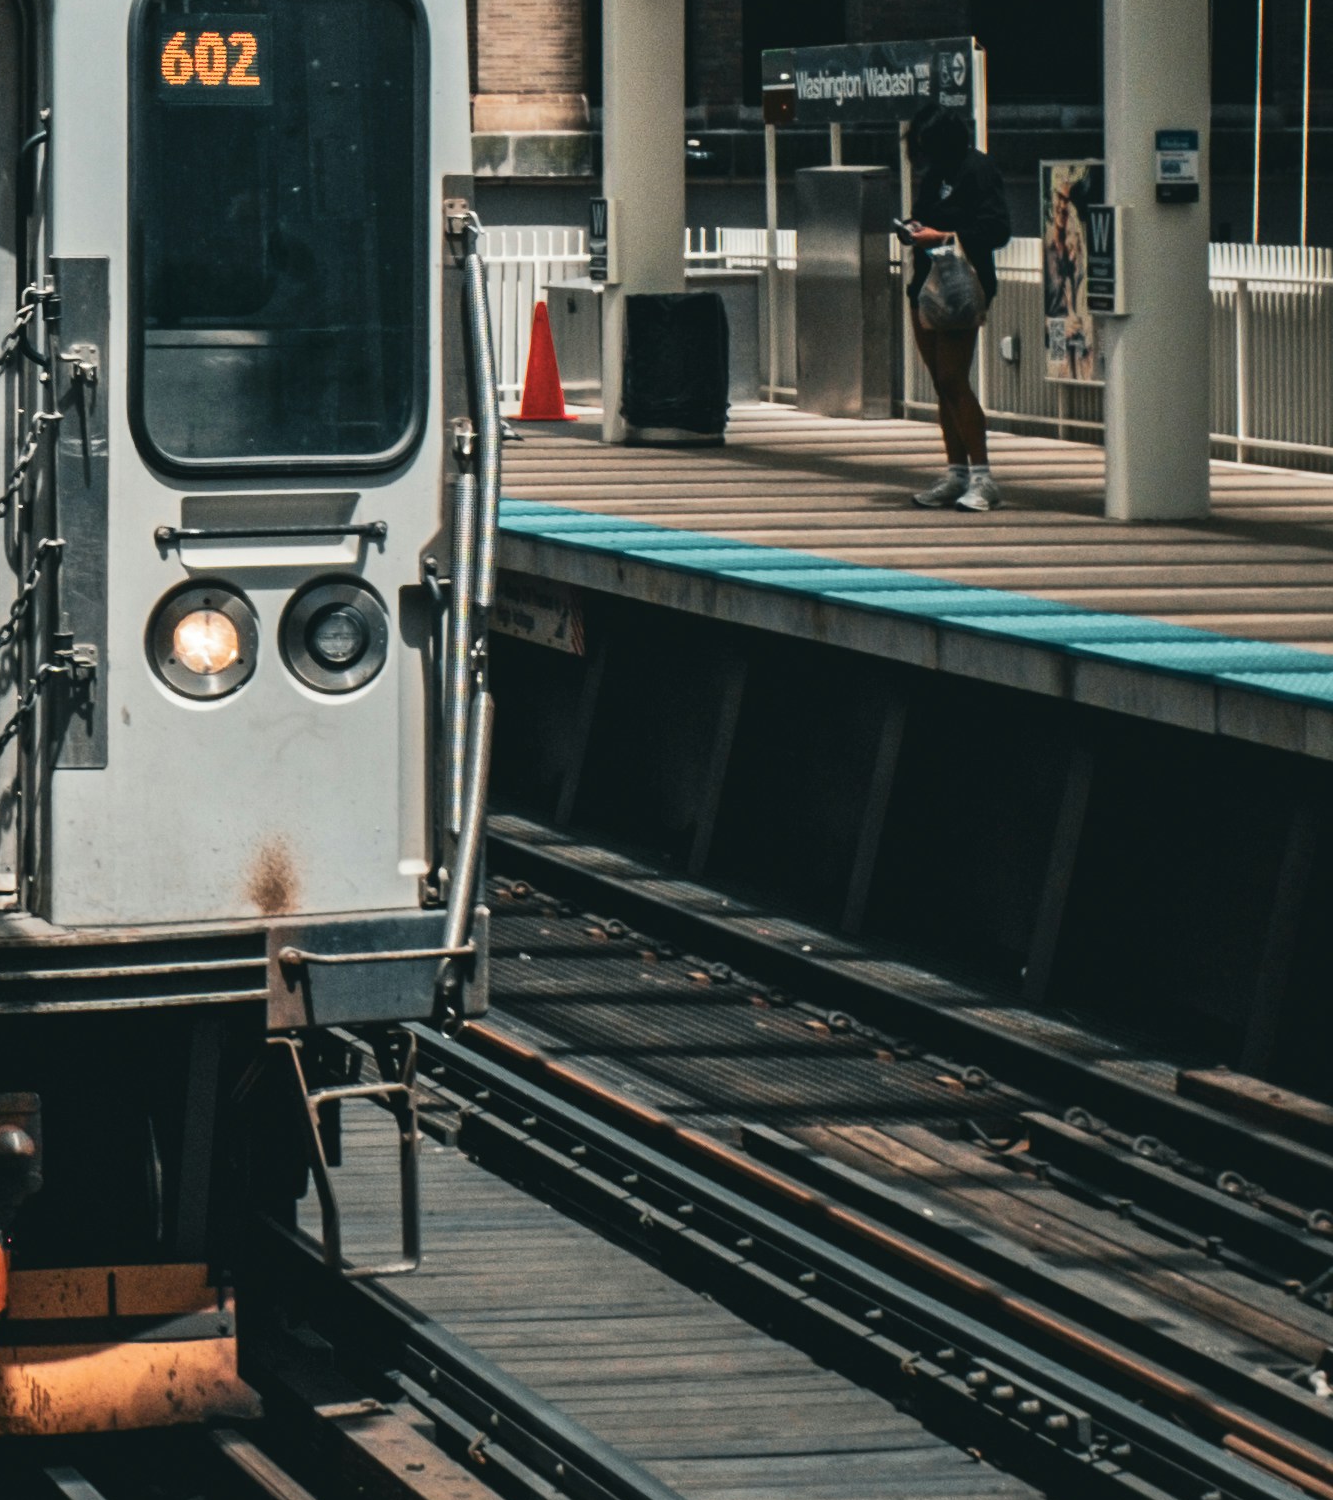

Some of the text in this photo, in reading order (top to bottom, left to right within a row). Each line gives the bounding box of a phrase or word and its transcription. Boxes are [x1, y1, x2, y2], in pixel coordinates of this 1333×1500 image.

[160, 31, 261, 86] 602
[795, 66, 915, 106] Washington/Wabash
[592, 203, 605, 236] W
[1090, 212, 1111, 253] W
